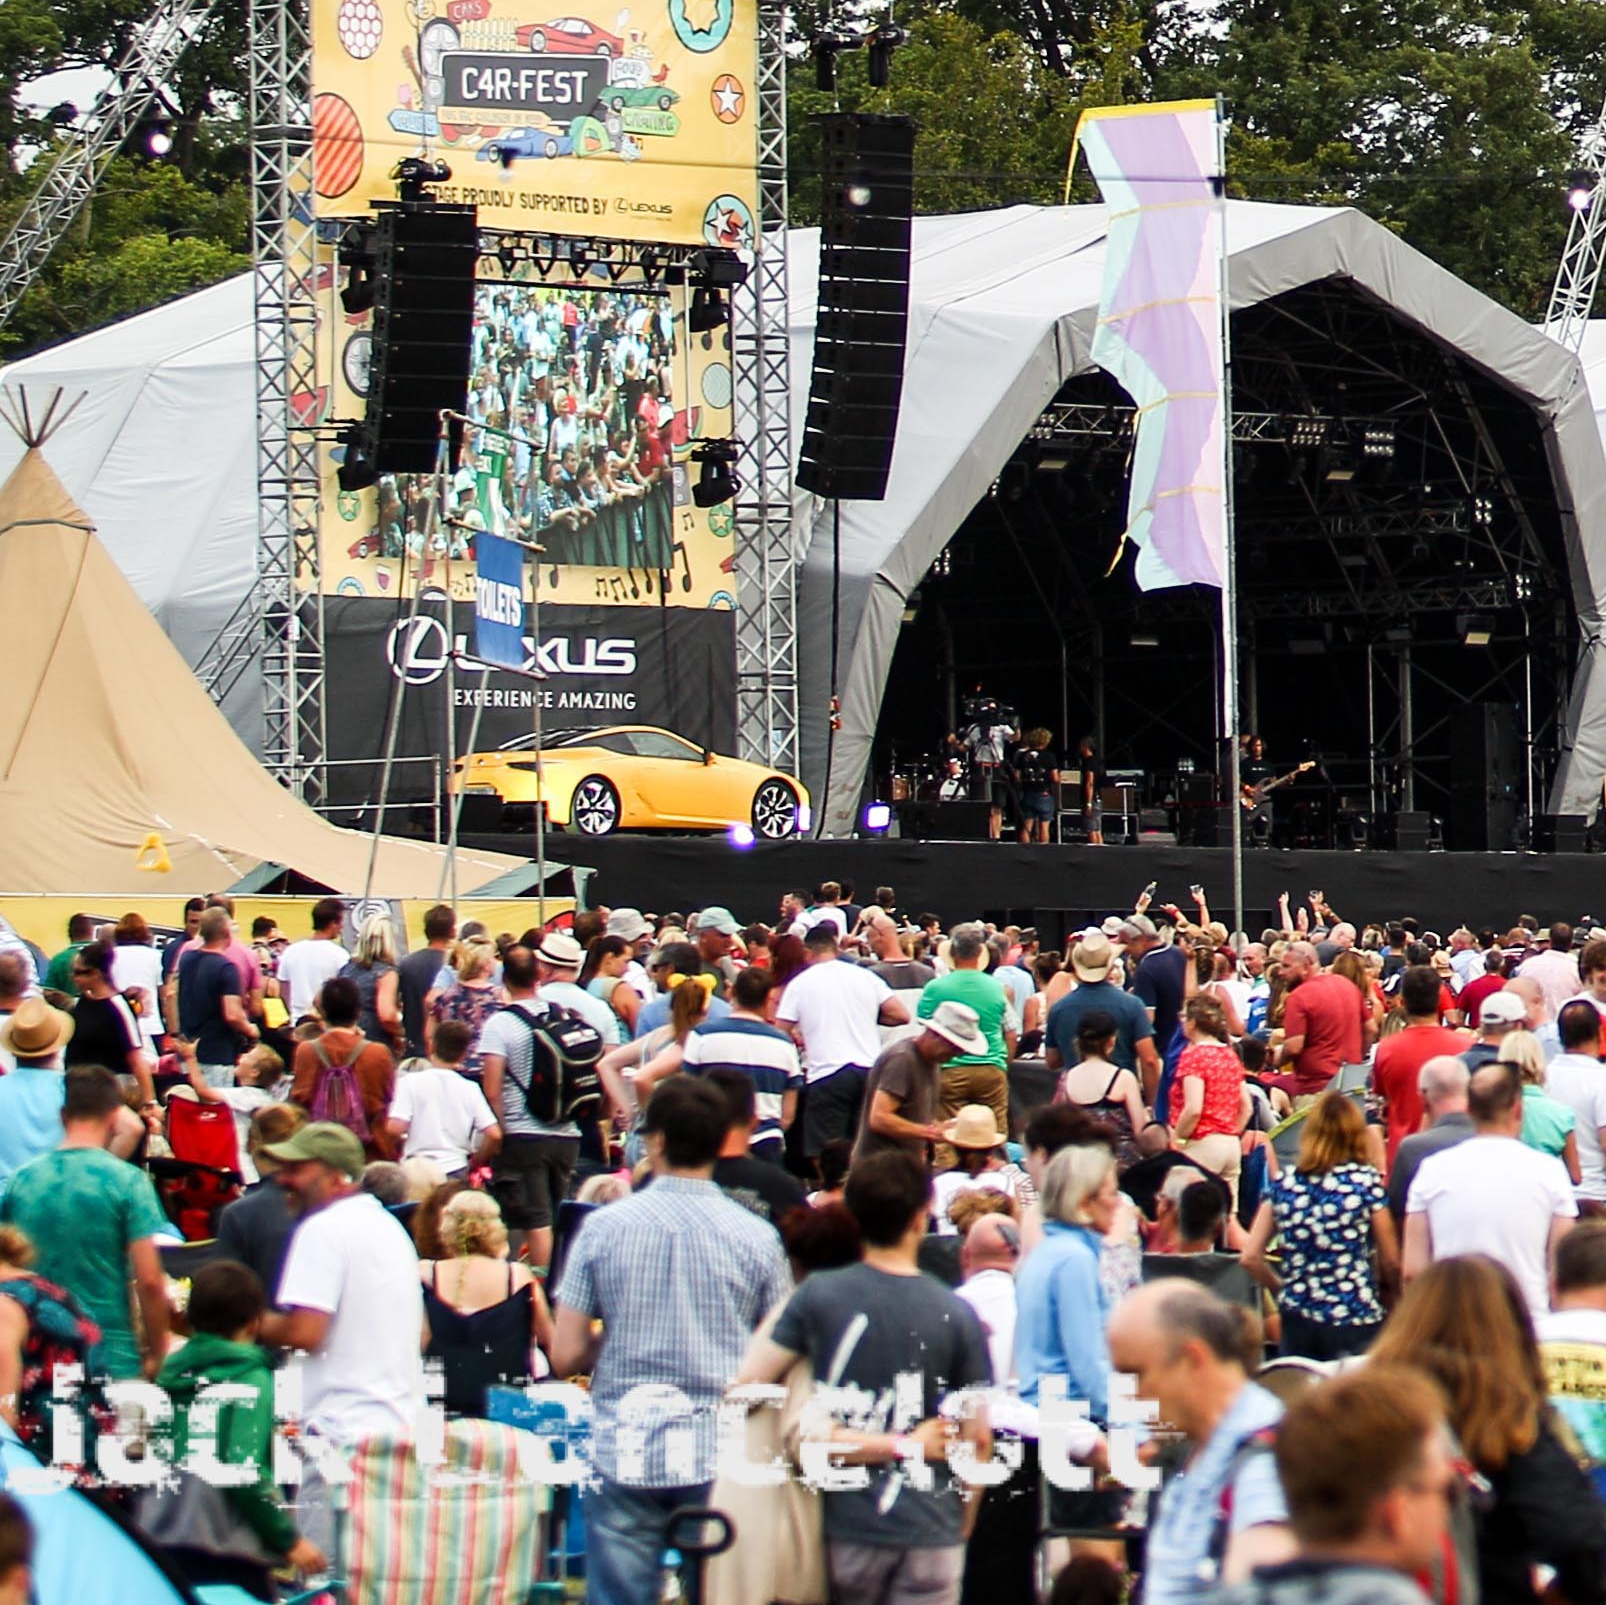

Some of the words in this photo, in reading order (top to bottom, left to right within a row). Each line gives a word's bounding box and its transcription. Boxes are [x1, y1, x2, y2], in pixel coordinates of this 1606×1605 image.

[462, 187, 515, 208] PROUDLY
[520, 192, 589, 214] SUPPORTED
[593, 197, 608, 215] BY
[475, 576, 522, 627] TOILETS
[455, 634, 637, 675] LXUS
[454, 689, 553, 709] EXPERIENCE
[558, 692, 637, 711] AMAZING
